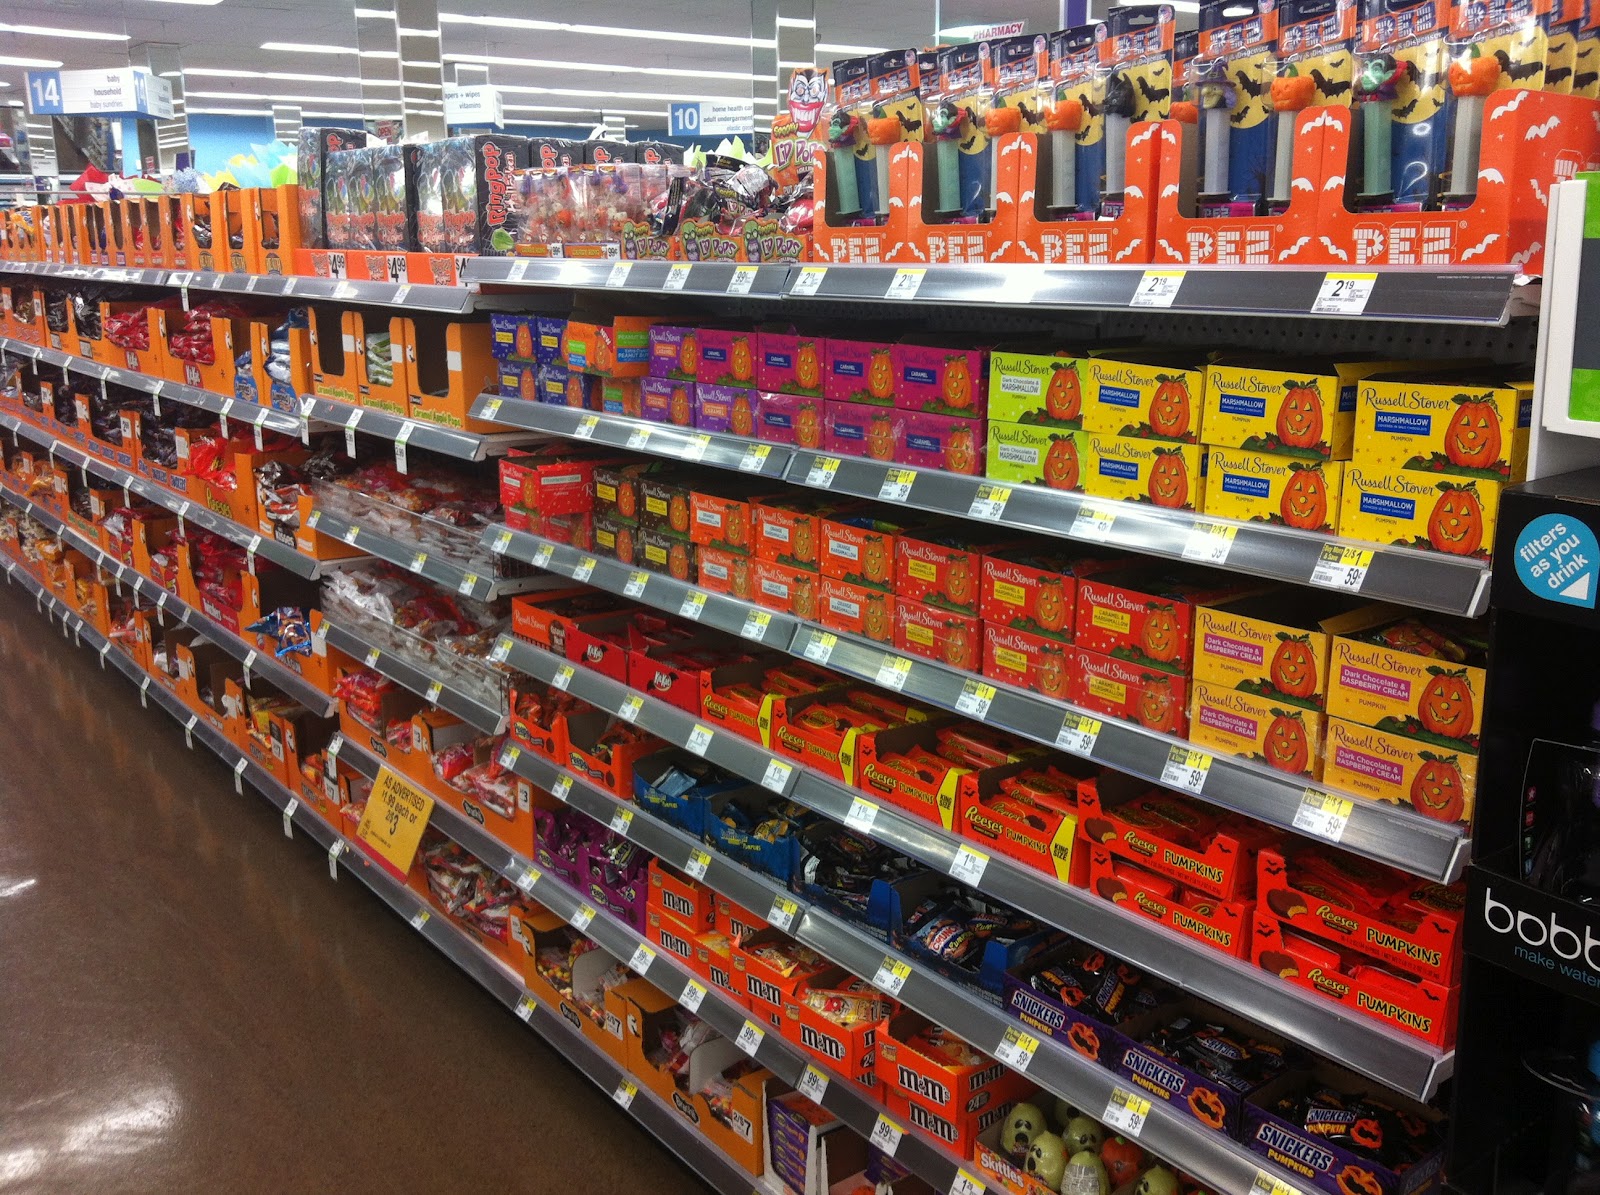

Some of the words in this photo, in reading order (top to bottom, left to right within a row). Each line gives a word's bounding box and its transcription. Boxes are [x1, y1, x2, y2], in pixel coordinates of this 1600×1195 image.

[973, 22, 1023, 41] PHARMACY
[106, 74, 120, 84] baby
[32, 78, 60, 107] 14
[94, 88, 121, 96] household
[674, 107, 698, 130] 10
[830, 236, 881, 263] PEZ
[926, 235, 985, 263] PEZ
[1040, 232, 1110, 264] PEZ
[1186, 229, 1276, 264] PEZ
[1352, 226, 1451, 264] PEZ
[992, 357, 1022, 374] Russell
[1023, 360, 1049, 375] Stover
[1090, 365, 1122, 384] Russell
[1122, 370, 1154, 387] Stover
[1001, 383, 1039, 394] MARSHMALLOW
[1100, 388, 1139, 399] MARSHMALLOW
[1210, 372, 1247, 395] Russell
[1247, 376, 1281, 395] Stover
[1221, 397, 1264, 408] MARSHMALLOW
[1361, 387, 1410, 410] Russell
[1410, 391, 1450, 412] Stover
[1377, 415, 1429, 426] MARSHMALLOW
[990, 426, 1020, 443] Russell
[1021, 429, 1048, 446] Stover
[999, 451, 1037, 464] MARSHMALLOW
[1089, 438, 1122, 457] Russell
[1122, 443, 1151, 460] Stover
[1100, 460, 1137, 472] MARSHMALLOW
[1212, 452, 1252, 474] Russell
[1253, 457, 1286, 477] Stover
[1224, 476, 1268, 490] MARSHMALLOW
[1347, 469, 1394, 491] Russell
[1394, 474, 1435, 497] Stover
[1363, 497, 1413, 511] MARSHMALLOW
[1375, 517, 1397, 525] PUMPKIN
[1520, 523, 1566, 562] filters
[1531, 559, 1550, 577] as
[1550, 534, 1580, 564] you
[984, 562, 1011, 581] Russell
[1012, 569, 1037, 587] Stover
[1548, 554, 1588, 588] drink
[1081, 586, 1115, 605] Russell
[1115, 594, 1145, 613] Stover
[1199, 612, 1238, 636] Russell
[1238, 622, 1273, 643] Stover
[986, 628, 1013, 648] Russell
[1014, 635, 1038, 654] Stover
[1205, 644, 1240, 659] RASPBERRY
[1240, 651, 1263, 663] CREAM
[1207, 637, 1222, 646] Dark
[1223, 641, 1254, 654] Chocolate
[1078, 654, 1111, 674] Russell
[1112, 663, 1140, 684] Stover
[1220, 663, 1244, 675] PUMPKIN
[1335, 642, 1381, 668] Russell
[1381, 654, 1423, 677] Stover
[1341, 676, 1382, 693] RASPBERRY
[1382, 686, 1409, 699] CREAM
[1344, 669, 1361, 679] Dark
[1362, 673, 1398, 688] Chocolate
[1358, 698, 1387, 710] PUMPKIN
[1331, 724, 1373, 750] Russell
[1374, 738, 1415, 762] Stover
[1336, 757, 1375, 777] RASPBERRY
[1375, 768, 1401, 782] CREAM
[1338, 750, 1356, 761] Dark
[1356, 754, 1391, 771] Chocolate
[384, 775, 392, 789] AS
[391, 781, 424, 811] ADVERTISED
[864, 764, 897, 788] Reese's
[899, 783, 934, 805] PUMPKINS
[1353, 779, 1380, 793] PUMPKIN
[965, 805, 1003, 835] Reese's
[1005, 829, 1047, 855] PUMPKINS
[1053, 849, 1067, 861] SIZE
[1054, 842, 1069, 855] KING
[1124, 831, 1158, 853] Reese's
[1164, 850, 1223, 883] PUMPKINS
[1134, 892, 1167, 915] Reese's
[1173, 912, 1231, 946] PUMPKINS
[1316, 905, 1358, 931] Reese's
[1366, 928, 1441, 967] PUMPKINS
[1514, 945, 1555, 970] make
[1559, 963, 1600, 988] water
[1012, 991, 1065, 1029] SNICKERS
[1307, 968, 1350, 995] Reese's
[1357, 991, 1431, 1033] PUMPKINS
[1020, 1012, 1053, 1036] PUMPKINS
[800, 1023, 845, 1061] m&m's
[898, 1063, 950, 1106] m&m's
[1124, 1051, 1185, 1093] SNICKERS
[1132, 1073, 1170, 1100] PUMPKINS
[909, 1101, 958, 1144] m&m's
[1308, 1109, 1356, 1123] SNICKERS
[1308, 1124, 1346, 1134] PUMPKIN
[1259, 1125, 1334, 1171] SNICKERS
[980, 1153, 1024, 1188] Skittles
[1268, 1149, 1315, 1178] PUMPKINS
